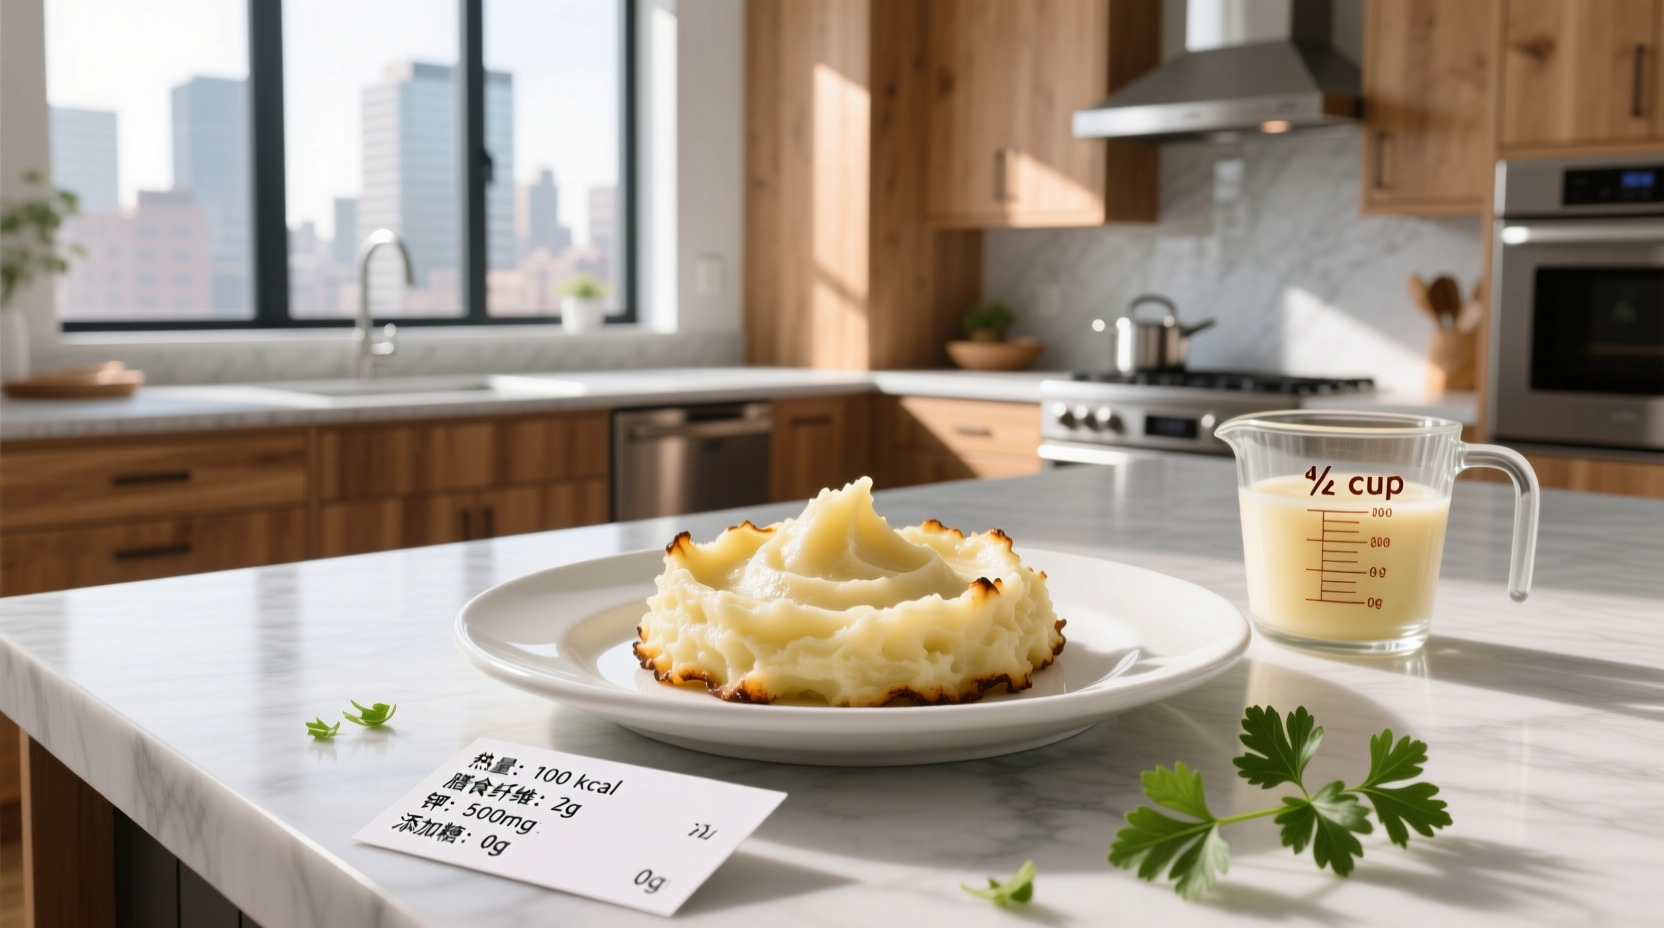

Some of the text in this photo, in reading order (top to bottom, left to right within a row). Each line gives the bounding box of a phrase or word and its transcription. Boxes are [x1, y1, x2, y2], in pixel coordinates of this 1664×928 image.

[1348, 475, 1404, 501] cup
[573, 773, 624, 796] kcal
[633, 868, 667, 894] 0g
